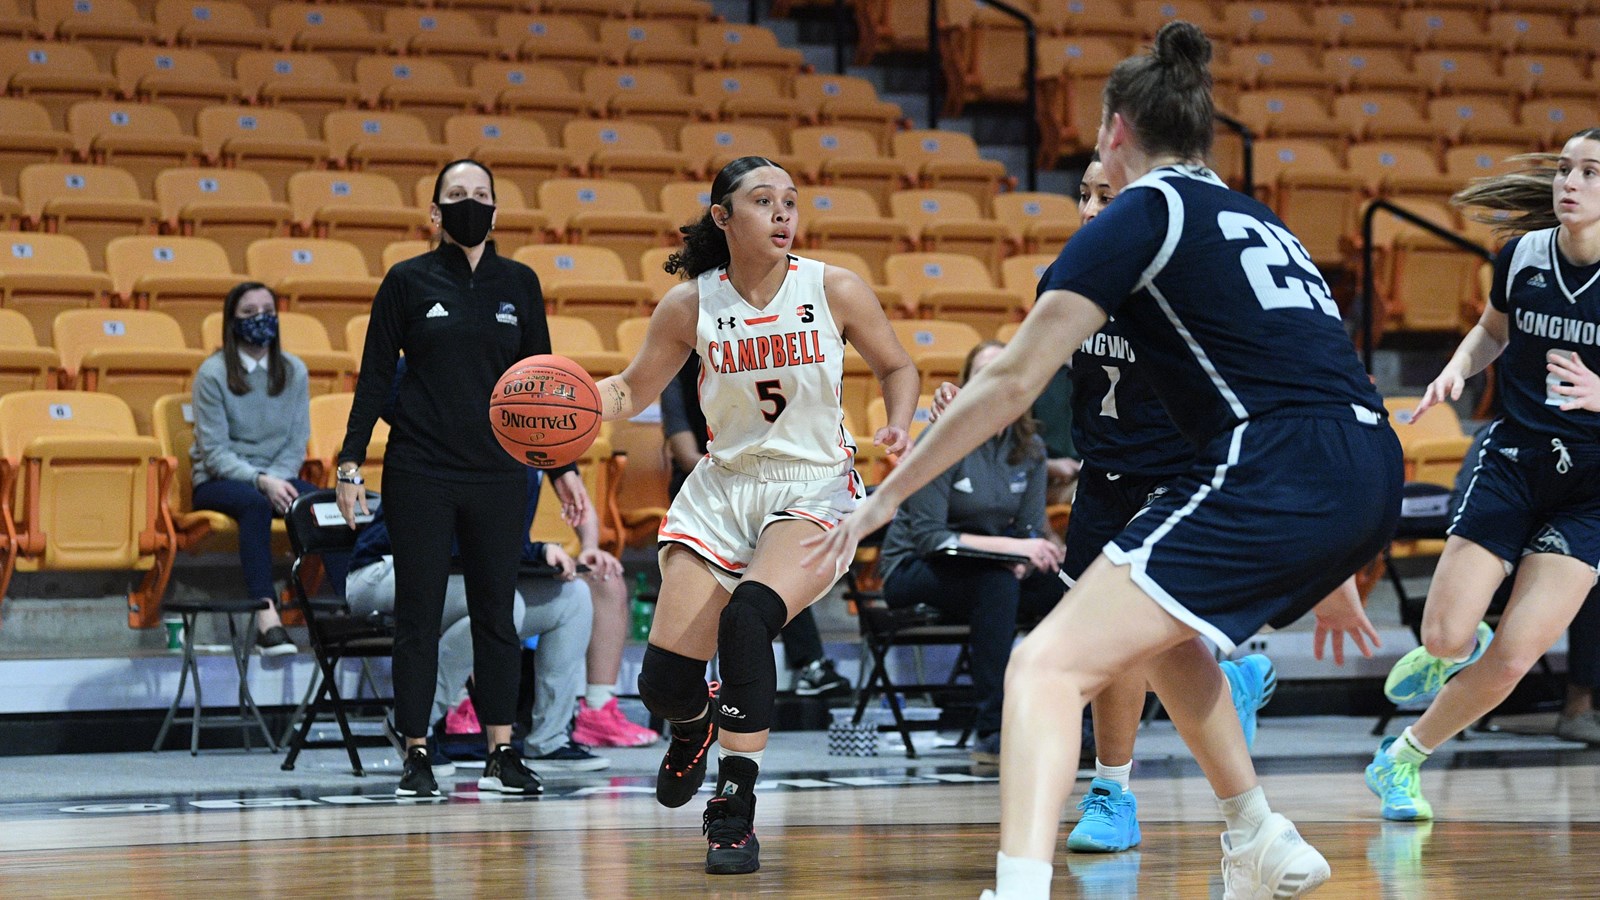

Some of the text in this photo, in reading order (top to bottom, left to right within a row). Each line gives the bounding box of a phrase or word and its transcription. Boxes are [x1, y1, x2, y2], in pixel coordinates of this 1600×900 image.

[708, 330, 825, 374] CAMPBELL
[755, 379, 787, 423] 5
[1099, 365, 1121, 420] 1
[501, 409, 577, 430] SPALDING
